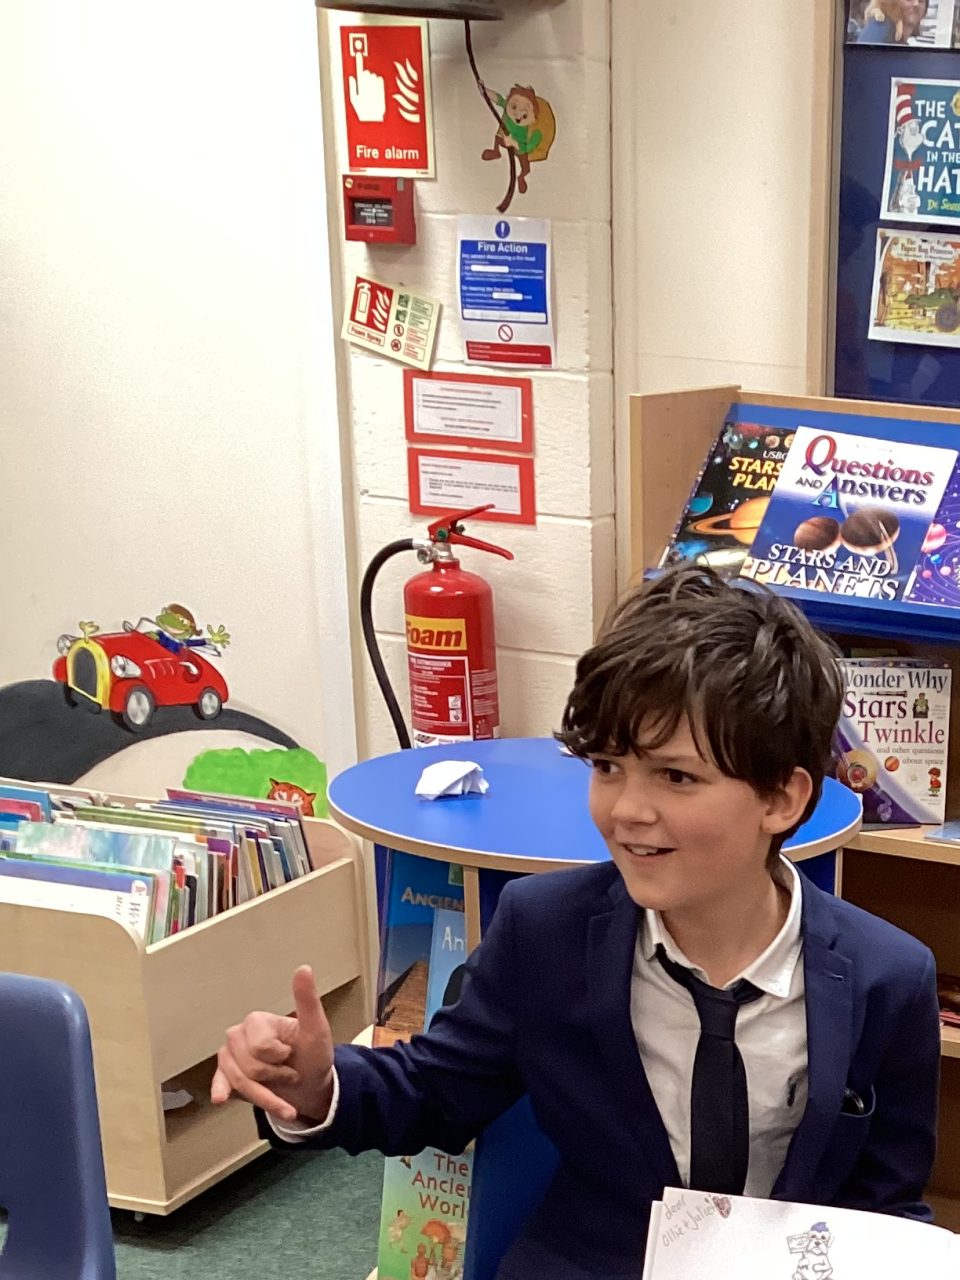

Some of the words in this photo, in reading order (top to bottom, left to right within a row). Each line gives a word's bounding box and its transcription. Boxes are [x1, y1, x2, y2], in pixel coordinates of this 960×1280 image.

[915, 100, 946, 118] THE
[356, 144, 379, 159] Fire
[385, 145, 419, 160] alarm
[926, 151, 938, 163] IN
[927, 199, 939, 210] Dr.
[940, 199, 960, 212] Seuss
[478, 242, 496, 252] Fire
[497, 243, 528, 254] Action
[802, 434, 935, 487] Questions
[795, 476, 823, 490] AND
[811, 473, 928, 510] Answers
[768, 543, 838, 570] STARS
[838, 556, 893, 579] AND
[750, 558, 900, 600] PLANETS
[908, 671, 948, 693] Why
[843, 691, 908, 719] Stars
[857, 720, 945, 744] Twinkle
[902, 757, 923, 765] about
[924, 758, 944, 766] space
[911, 748, 945, 756] questions
[433, 1152, 469, 1178] The
